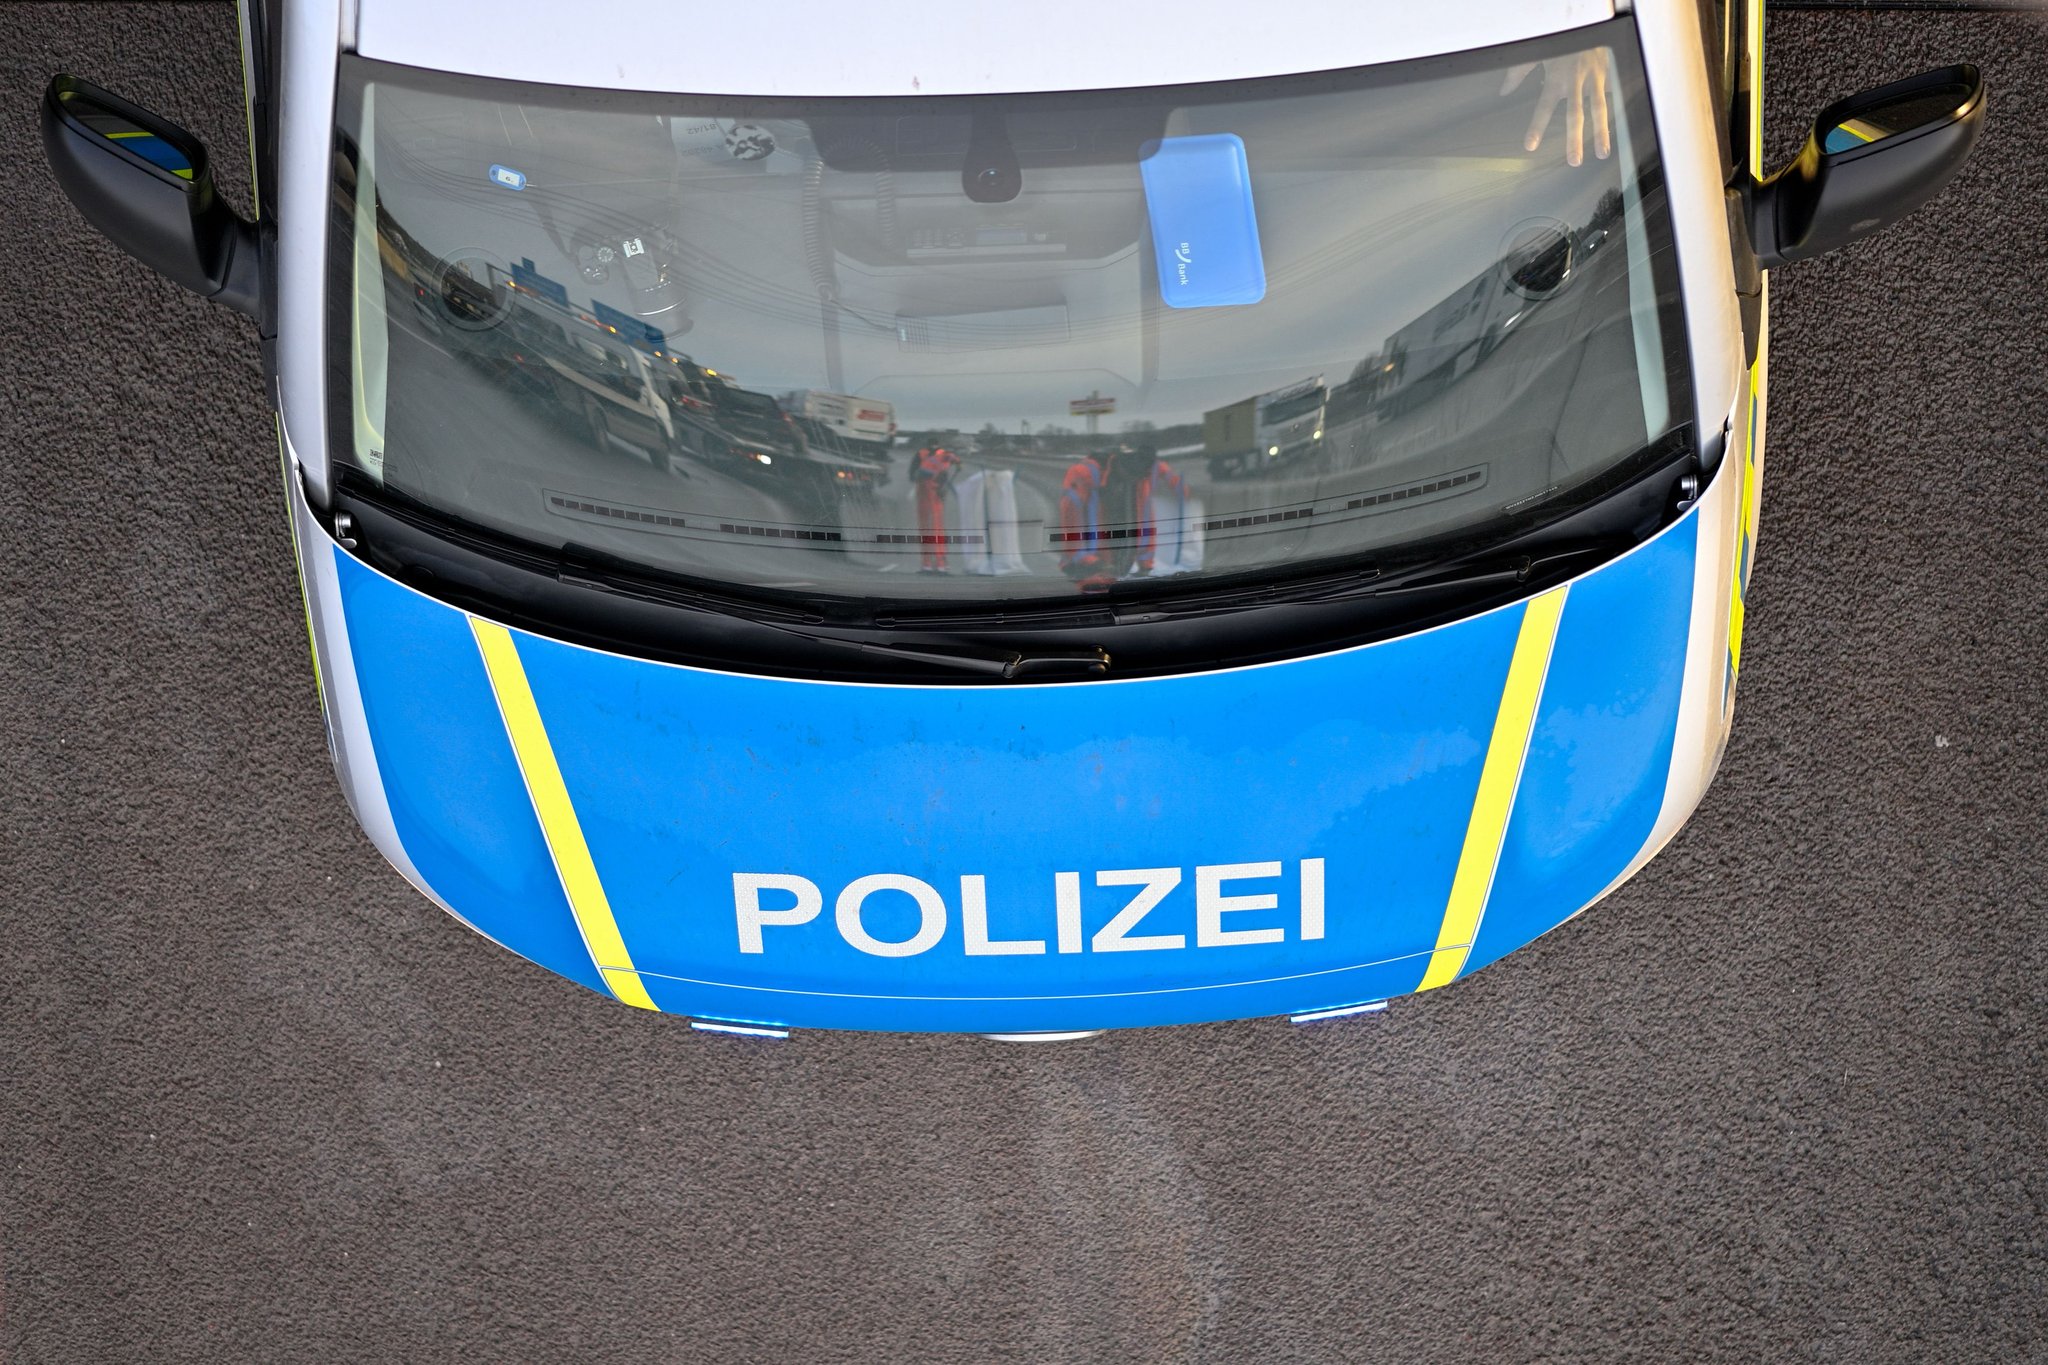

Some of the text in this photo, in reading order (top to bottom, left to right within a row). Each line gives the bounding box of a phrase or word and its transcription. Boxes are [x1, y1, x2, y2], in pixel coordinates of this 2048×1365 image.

[1177, 242, 1190, 285] BB Bank
[732, 857, 1326, 958] POLIZEI
